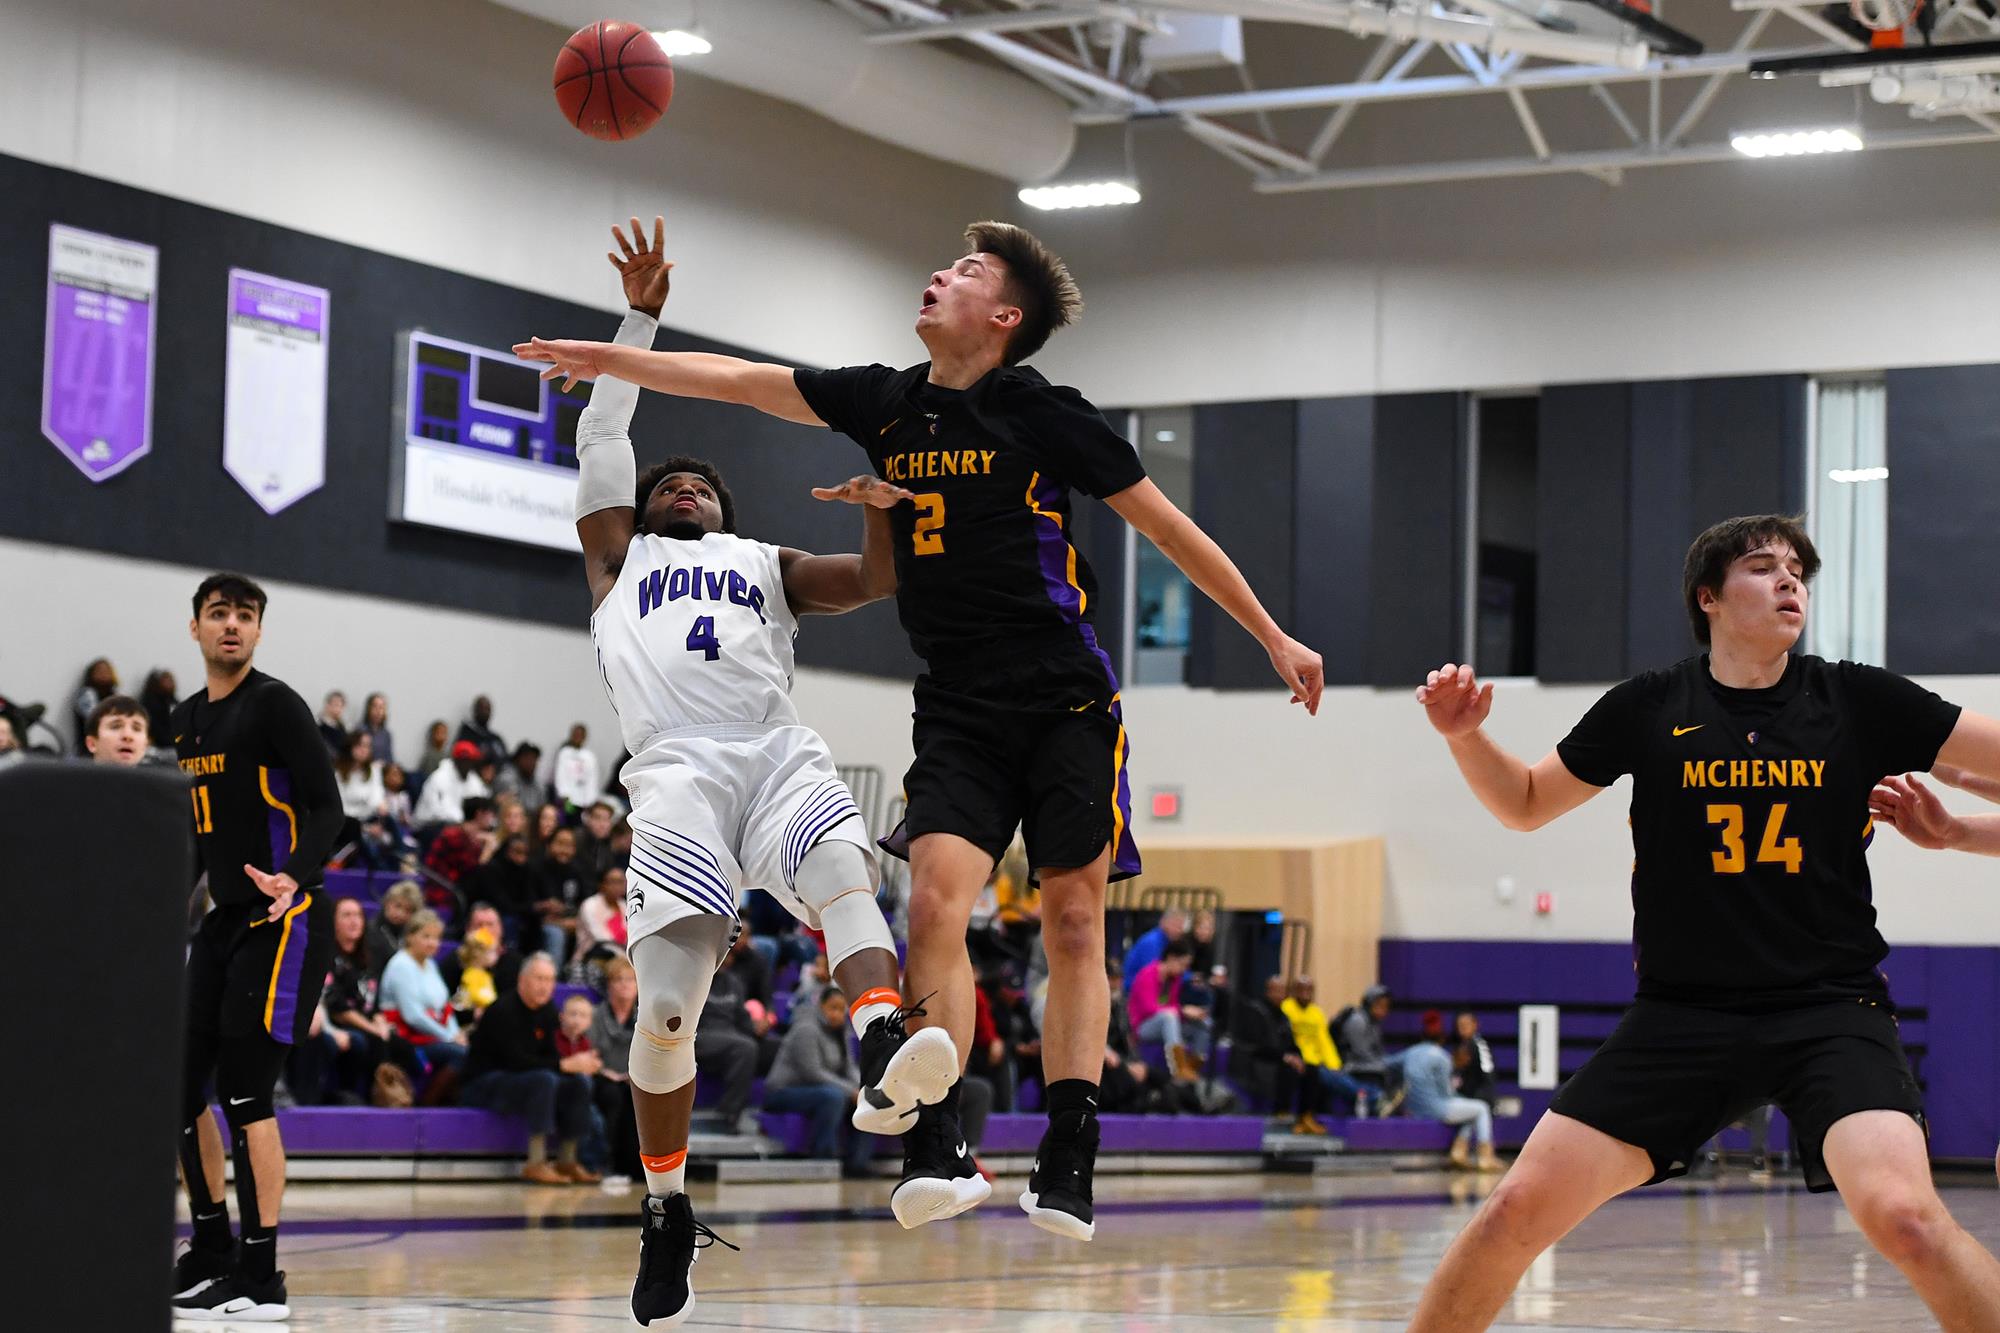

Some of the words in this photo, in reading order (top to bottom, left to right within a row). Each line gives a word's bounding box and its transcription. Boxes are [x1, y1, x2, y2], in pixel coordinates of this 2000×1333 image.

[883, 450, 997, 482] MCHENRY
[912, 492, 945, 556] 2
[686, 615, 721, 662] 4
[1681, 759, 1826, 788] MCHENRY
[1706, 803, 1803, 874] 34
